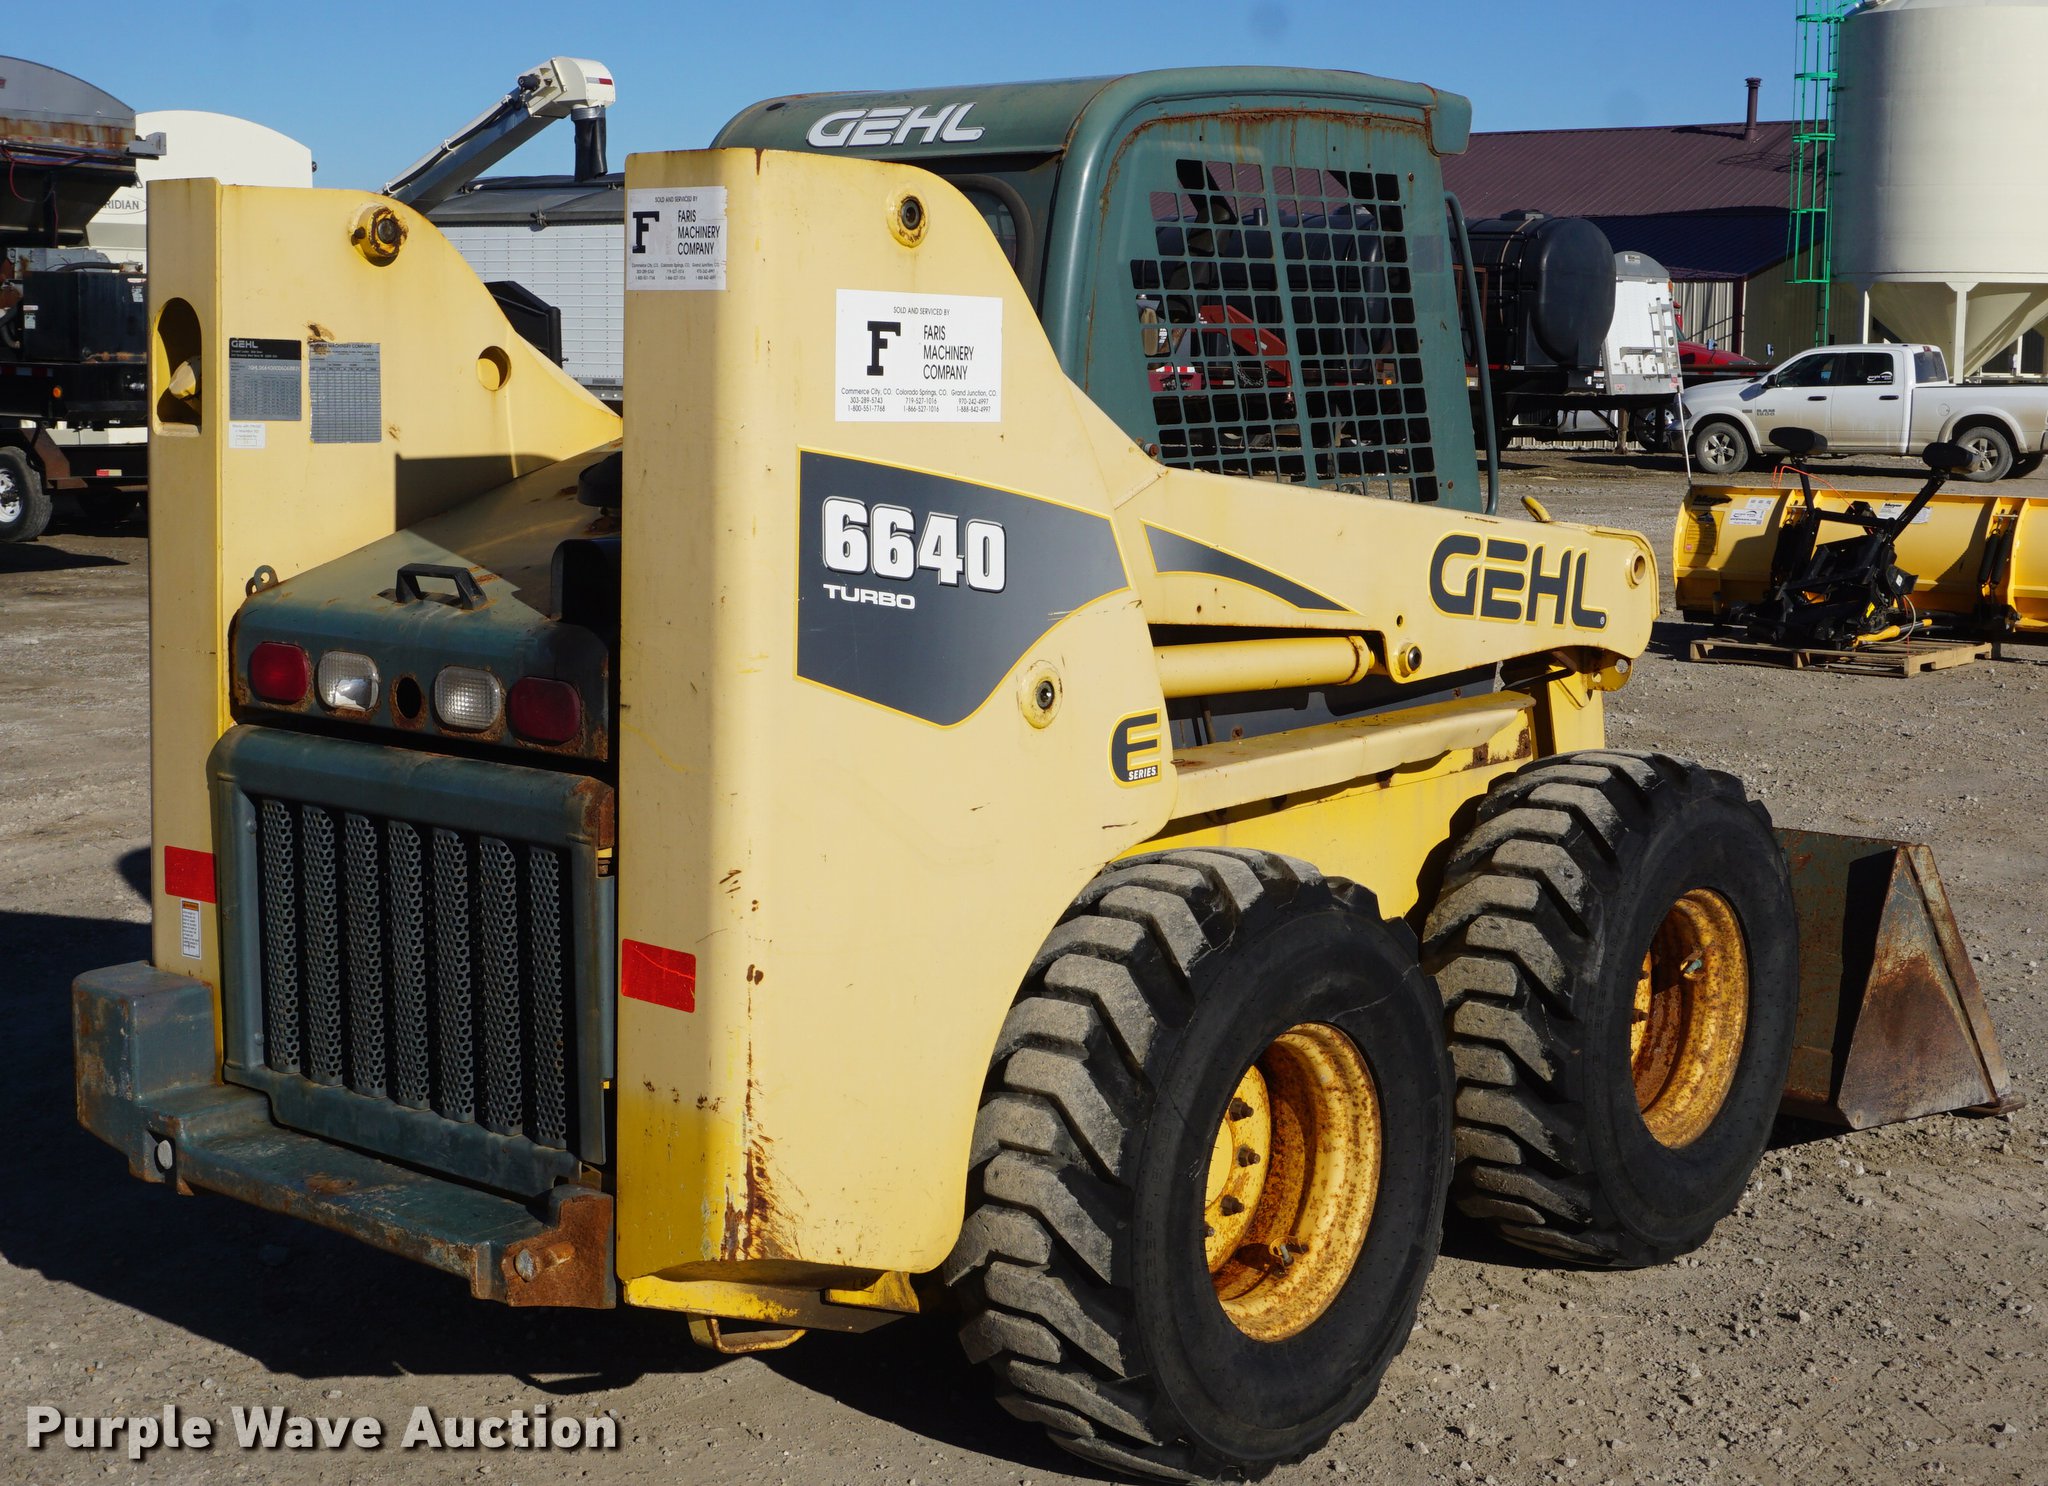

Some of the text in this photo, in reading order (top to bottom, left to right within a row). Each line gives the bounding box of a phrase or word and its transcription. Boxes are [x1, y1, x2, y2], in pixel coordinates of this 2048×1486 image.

[806, 102, 985, 147] GEHL
[104, 200, 139, 210] RIDIAN
[678, 209, 697, 222] FARIS
[632, 211, 660, 254] F
[677, 225, 720, 239] MACHINERY
[677, 242, 714, 255] COMPANY
[893, 306, 951, 316] SOLD AND SERVICED BY
[923, 325, 946, 341] FARIS
[231, 340, 259, 349] GEHL
[866, 320, 901, 376] F
[923, 345, 975, 361] MACHINERY
[923, 364, 968, 380] COMPANY
[841, 387, 870, 396] Commerce
[895, 388, 918, 396] Colorado
[822, 496, 1006, 593] 6640
[1428, 532, 1608, 631] GEHL
[823, 584, 915, 610] TURBO
[1109, 709, 1160, 786] E
[1128, 766, 1157, 780] SERIES
